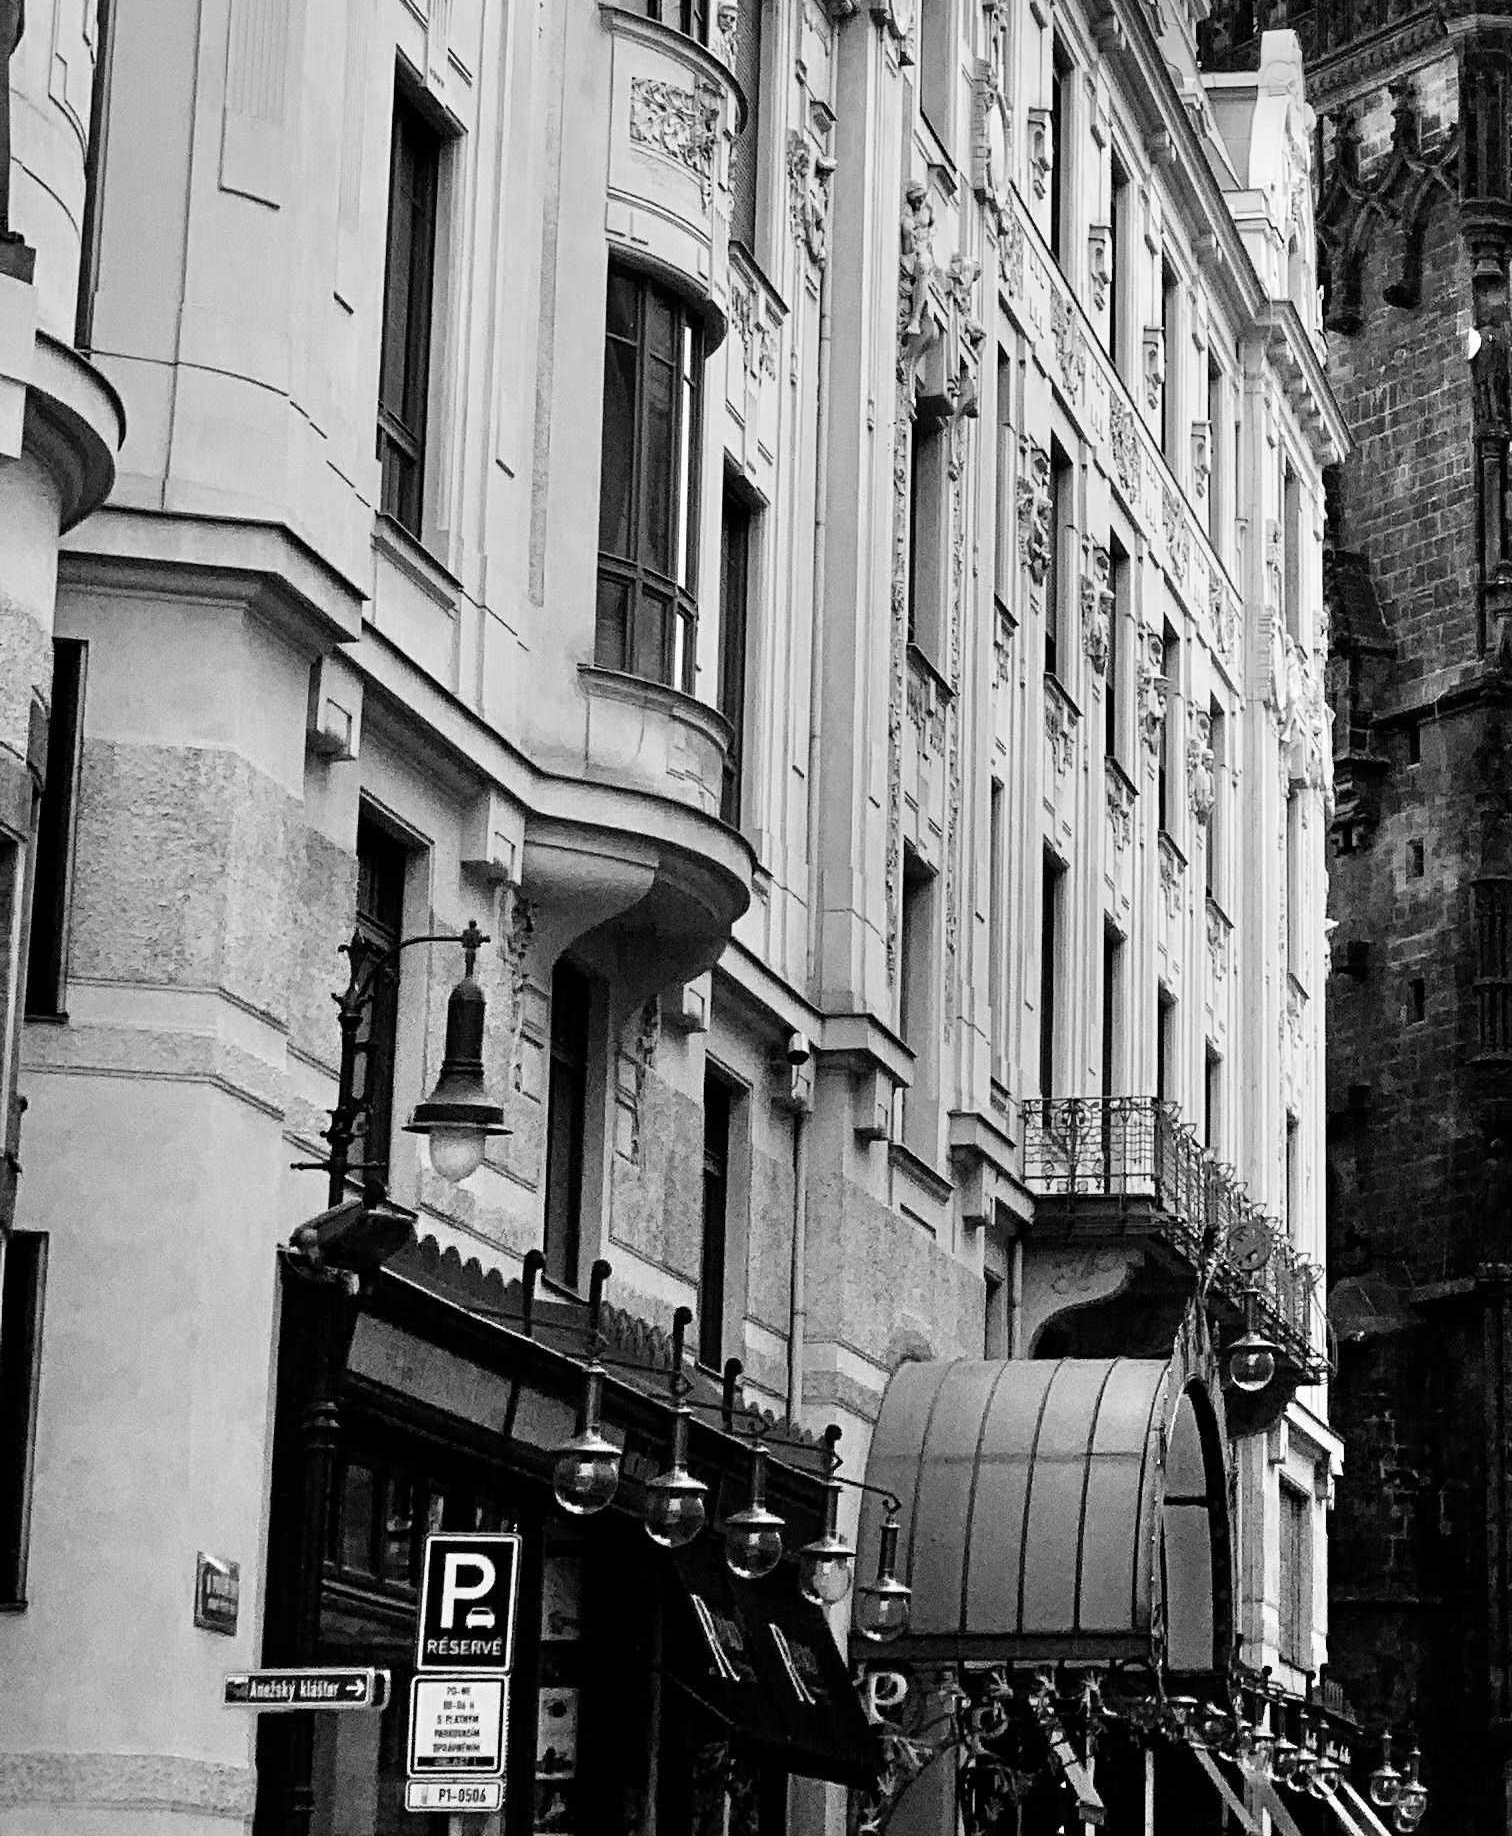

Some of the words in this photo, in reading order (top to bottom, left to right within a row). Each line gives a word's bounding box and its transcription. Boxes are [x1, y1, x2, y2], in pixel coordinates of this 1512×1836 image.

[440, 1553, 496, 1628] P
[427, 1636, 502, 1655] RÉSERVÉ
[438, 1788, 486, 1802] P1-0506
